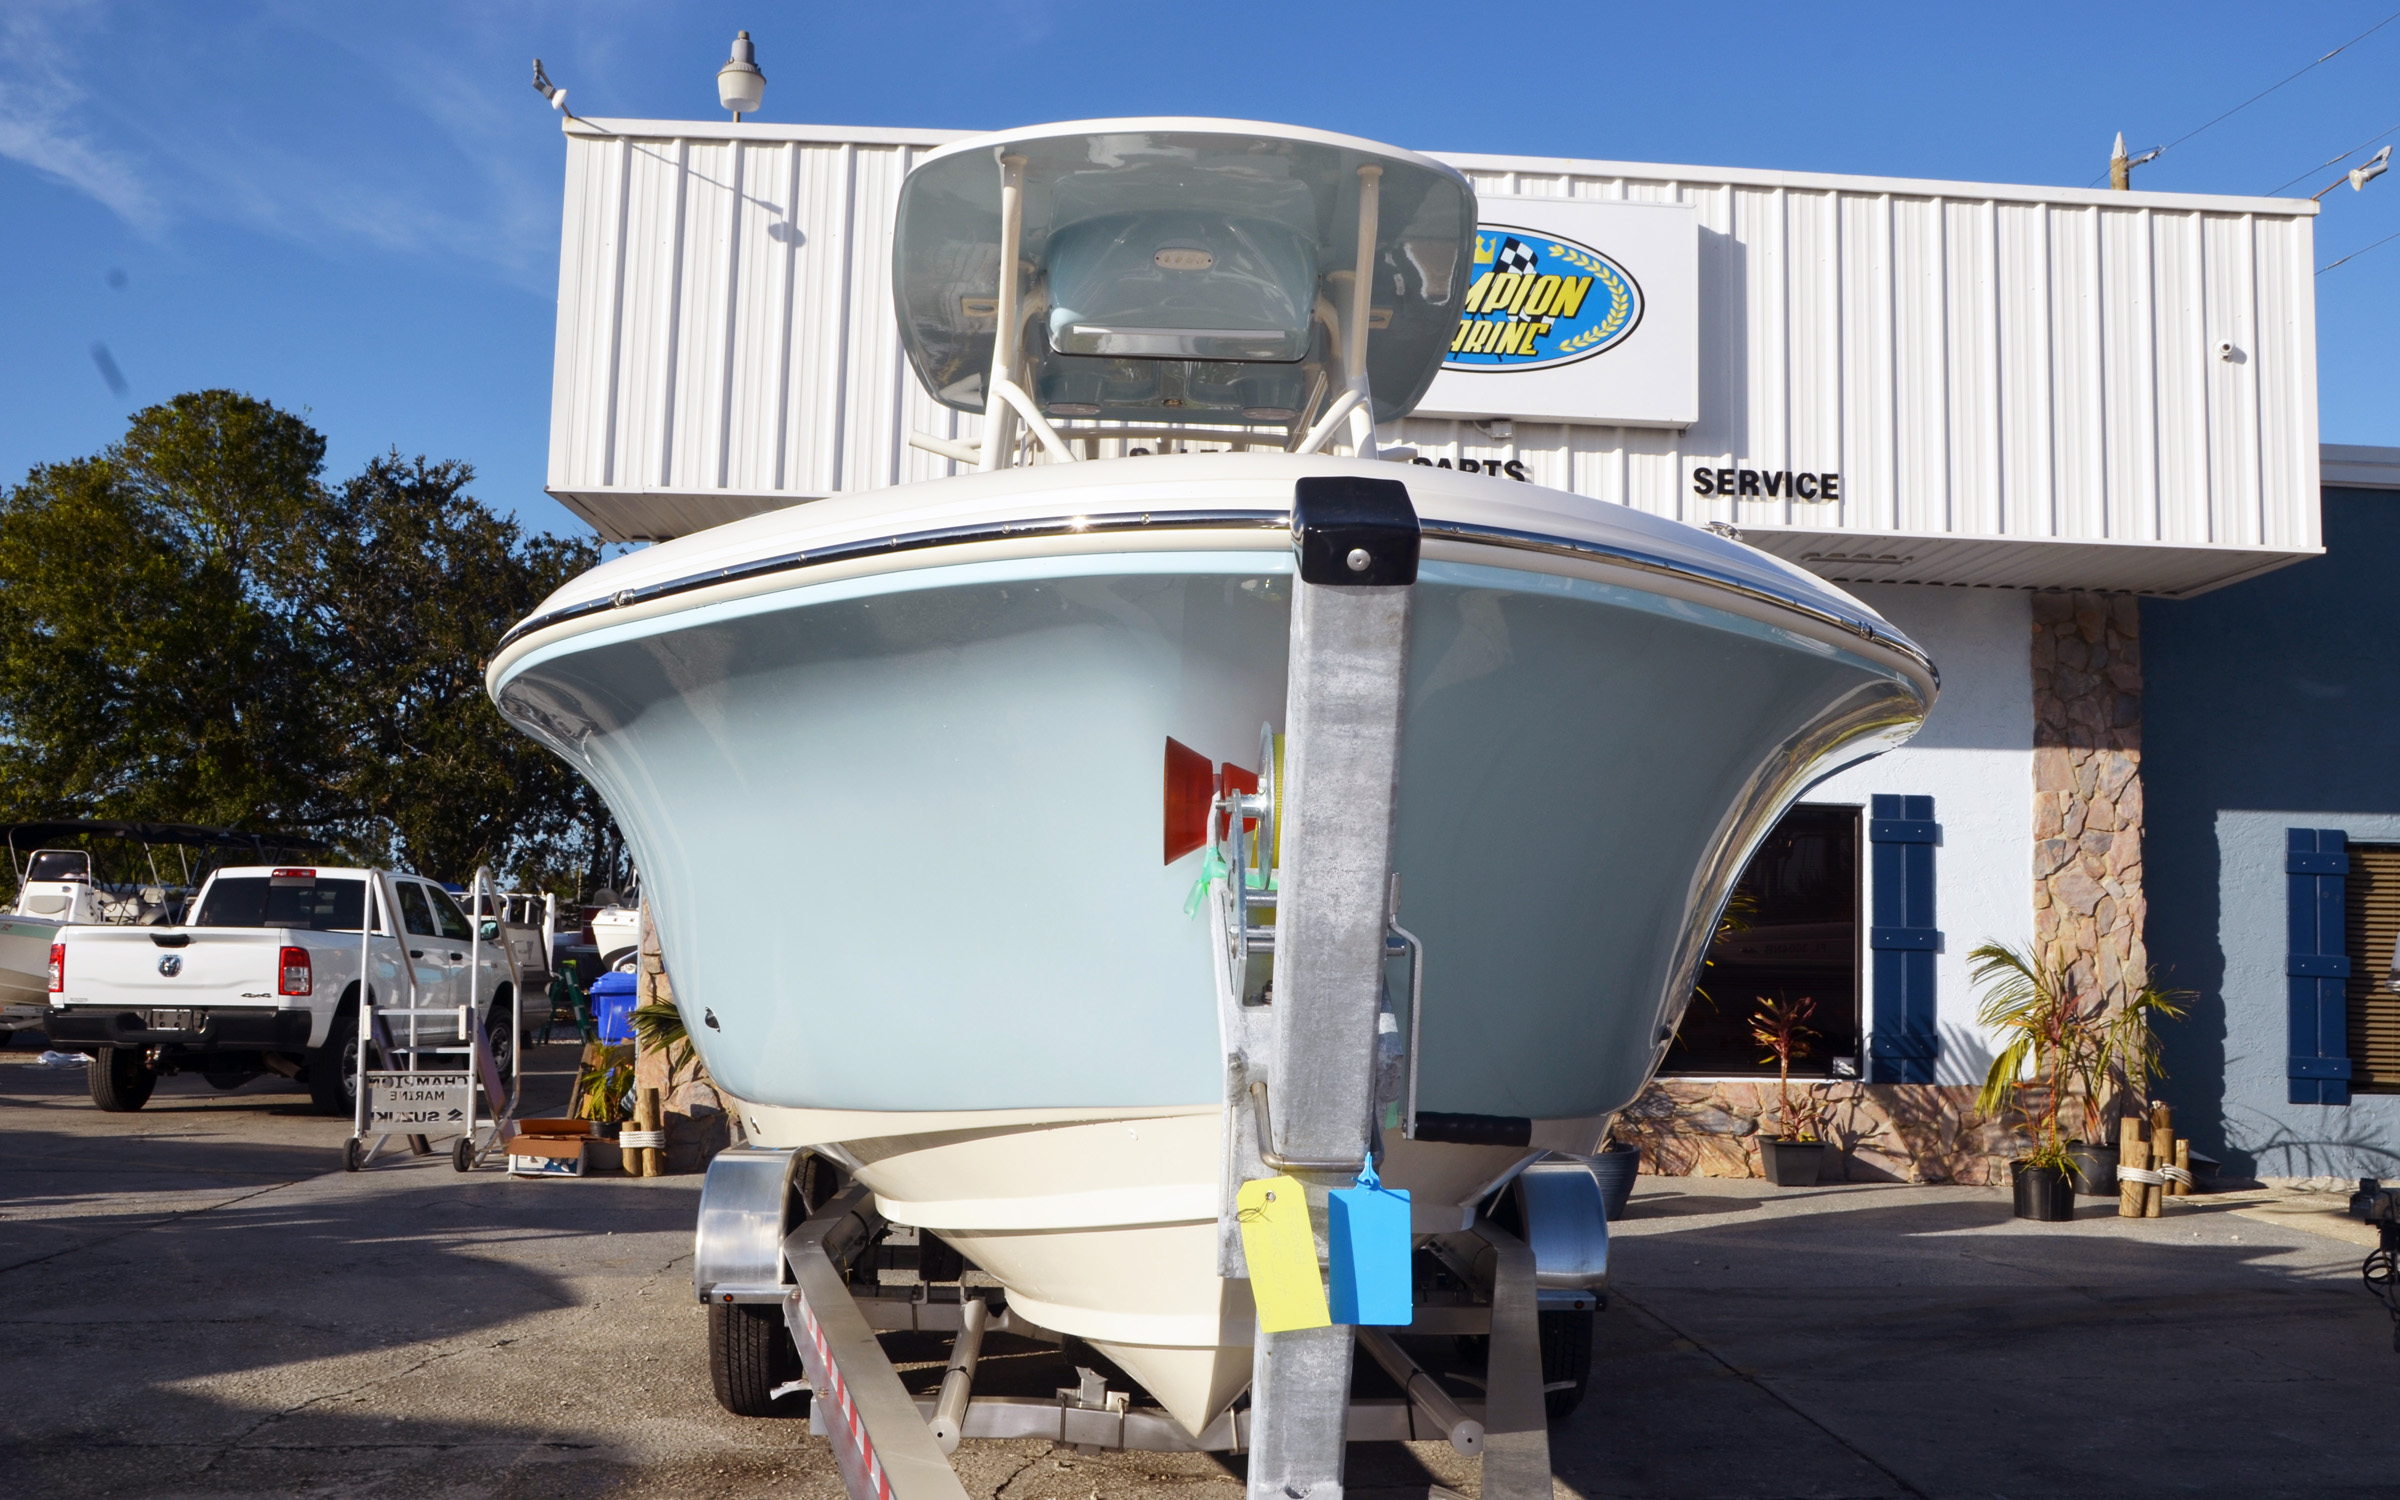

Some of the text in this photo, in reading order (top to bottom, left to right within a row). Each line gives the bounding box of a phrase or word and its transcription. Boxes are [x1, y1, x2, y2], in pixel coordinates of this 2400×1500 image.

[1465, 272, 1594, 318] MPION
[1450, 320, 1550, 356] ARINE
[1693, 467, 1839, 499] SERVICE
